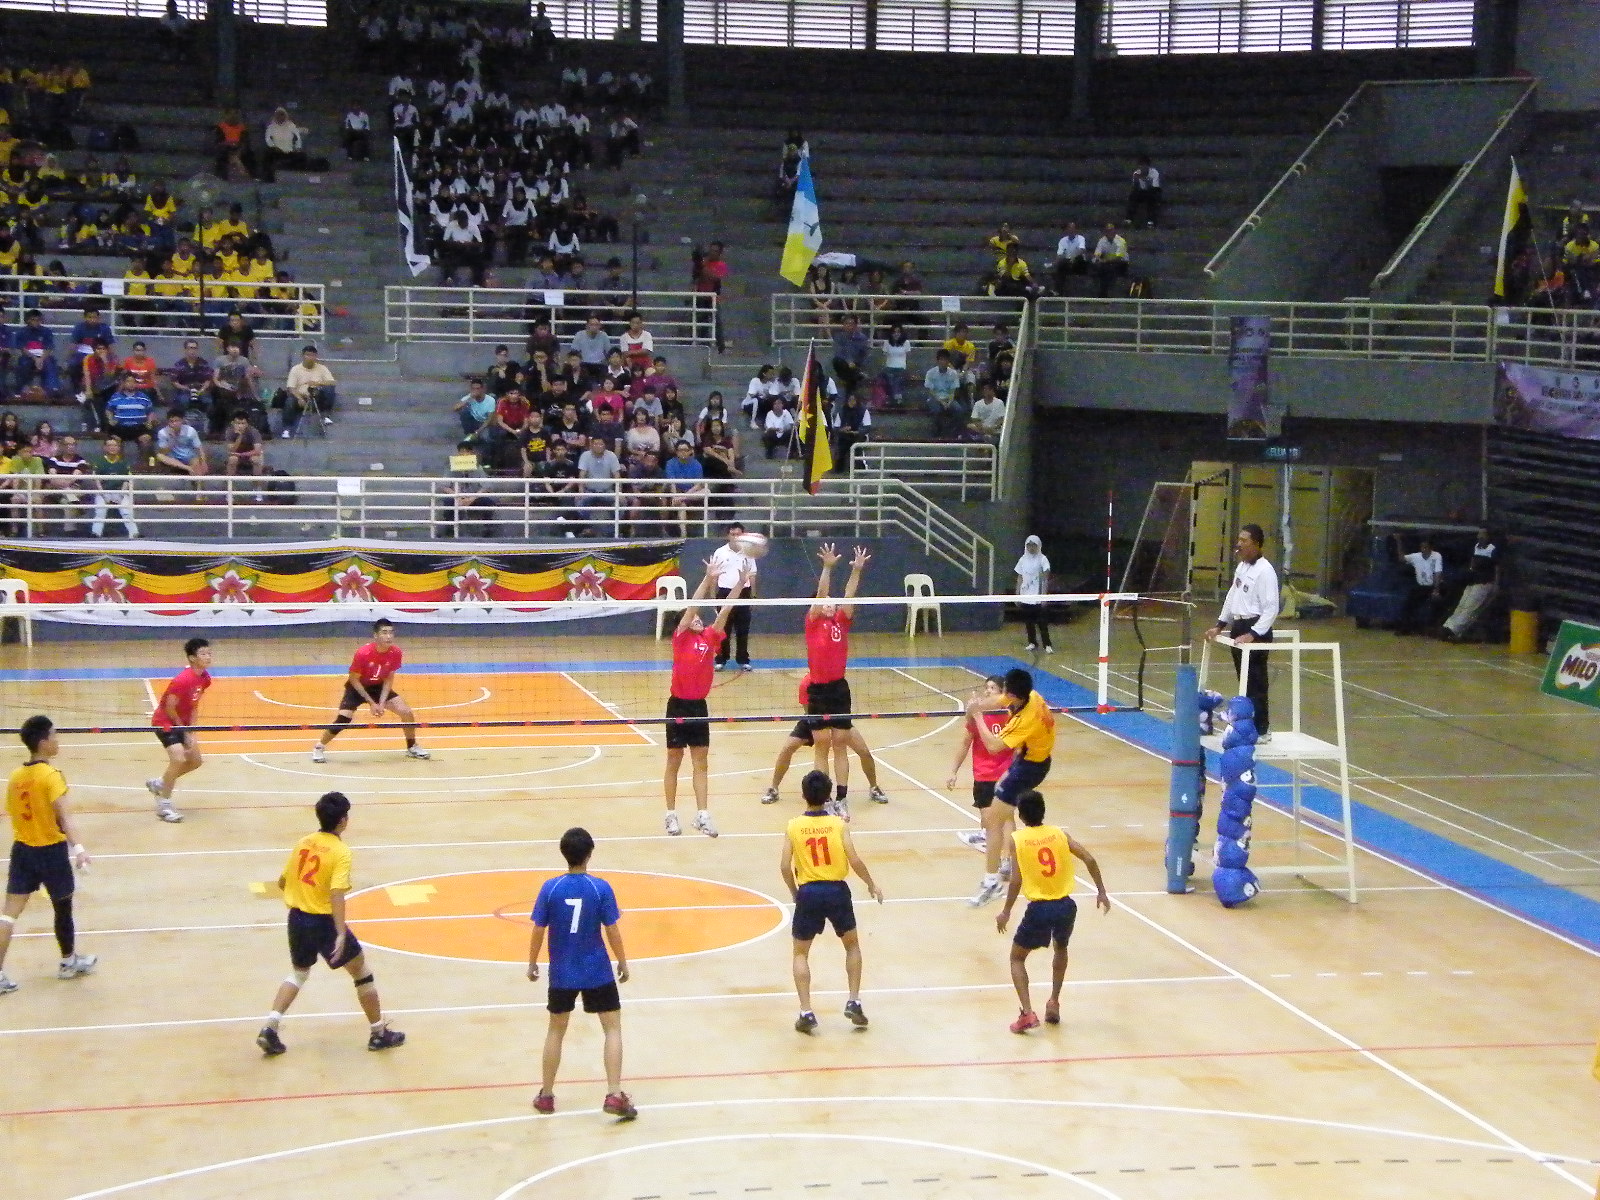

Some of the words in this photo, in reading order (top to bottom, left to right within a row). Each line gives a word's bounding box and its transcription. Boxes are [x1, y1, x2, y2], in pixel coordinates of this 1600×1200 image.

[1560, 654, 1598, 681] MILO
[20, 791, 33, 821] 3
[800, 826, 834, 835] SELANGOR
[805, 836, 832, 867] 11
[1037, 846, 1056, 878] 9
[297, 848, 321, 887] 12
[564, 898, 583, 934] 7
